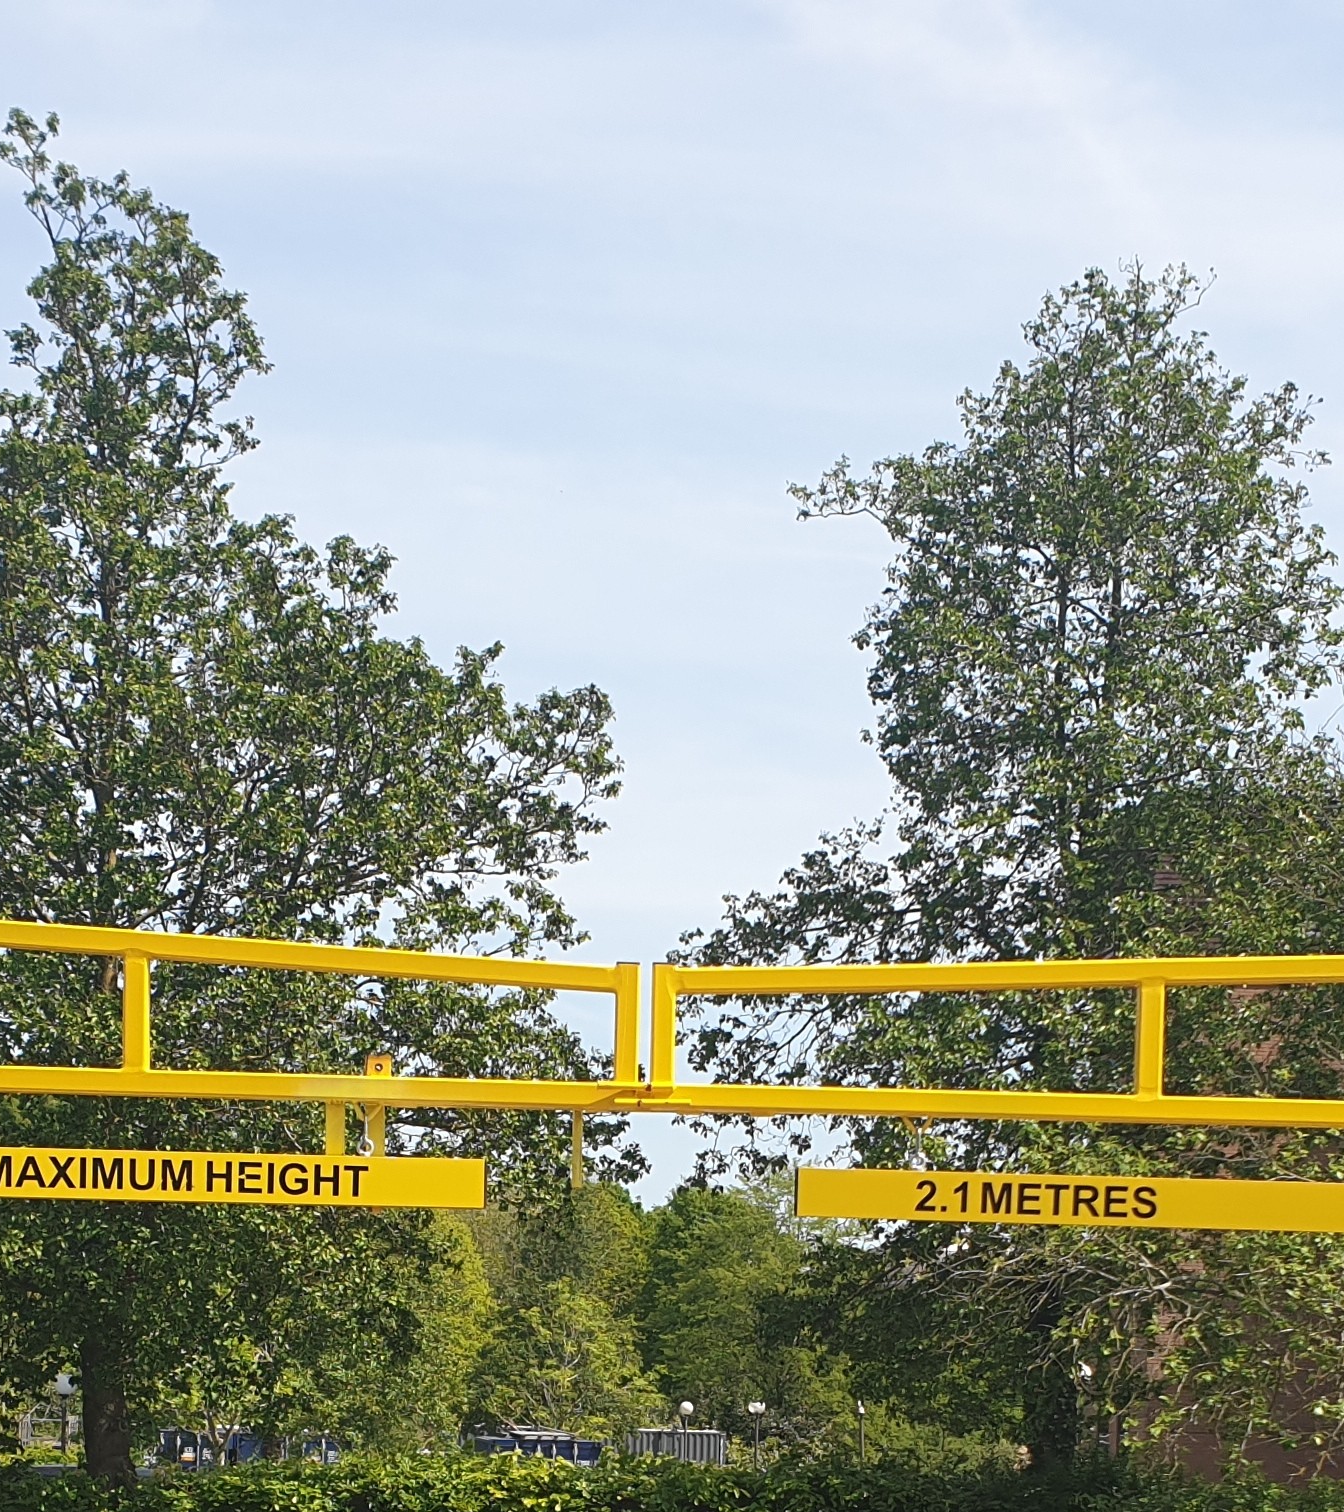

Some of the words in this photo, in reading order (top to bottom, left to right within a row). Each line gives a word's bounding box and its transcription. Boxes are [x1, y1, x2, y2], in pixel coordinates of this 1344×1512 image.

[206, 1160, 368, 1198] HEIGHT
[914, 1180, 969, 1213] 2.1
[980, 1182, 1157, 1219] METRES
